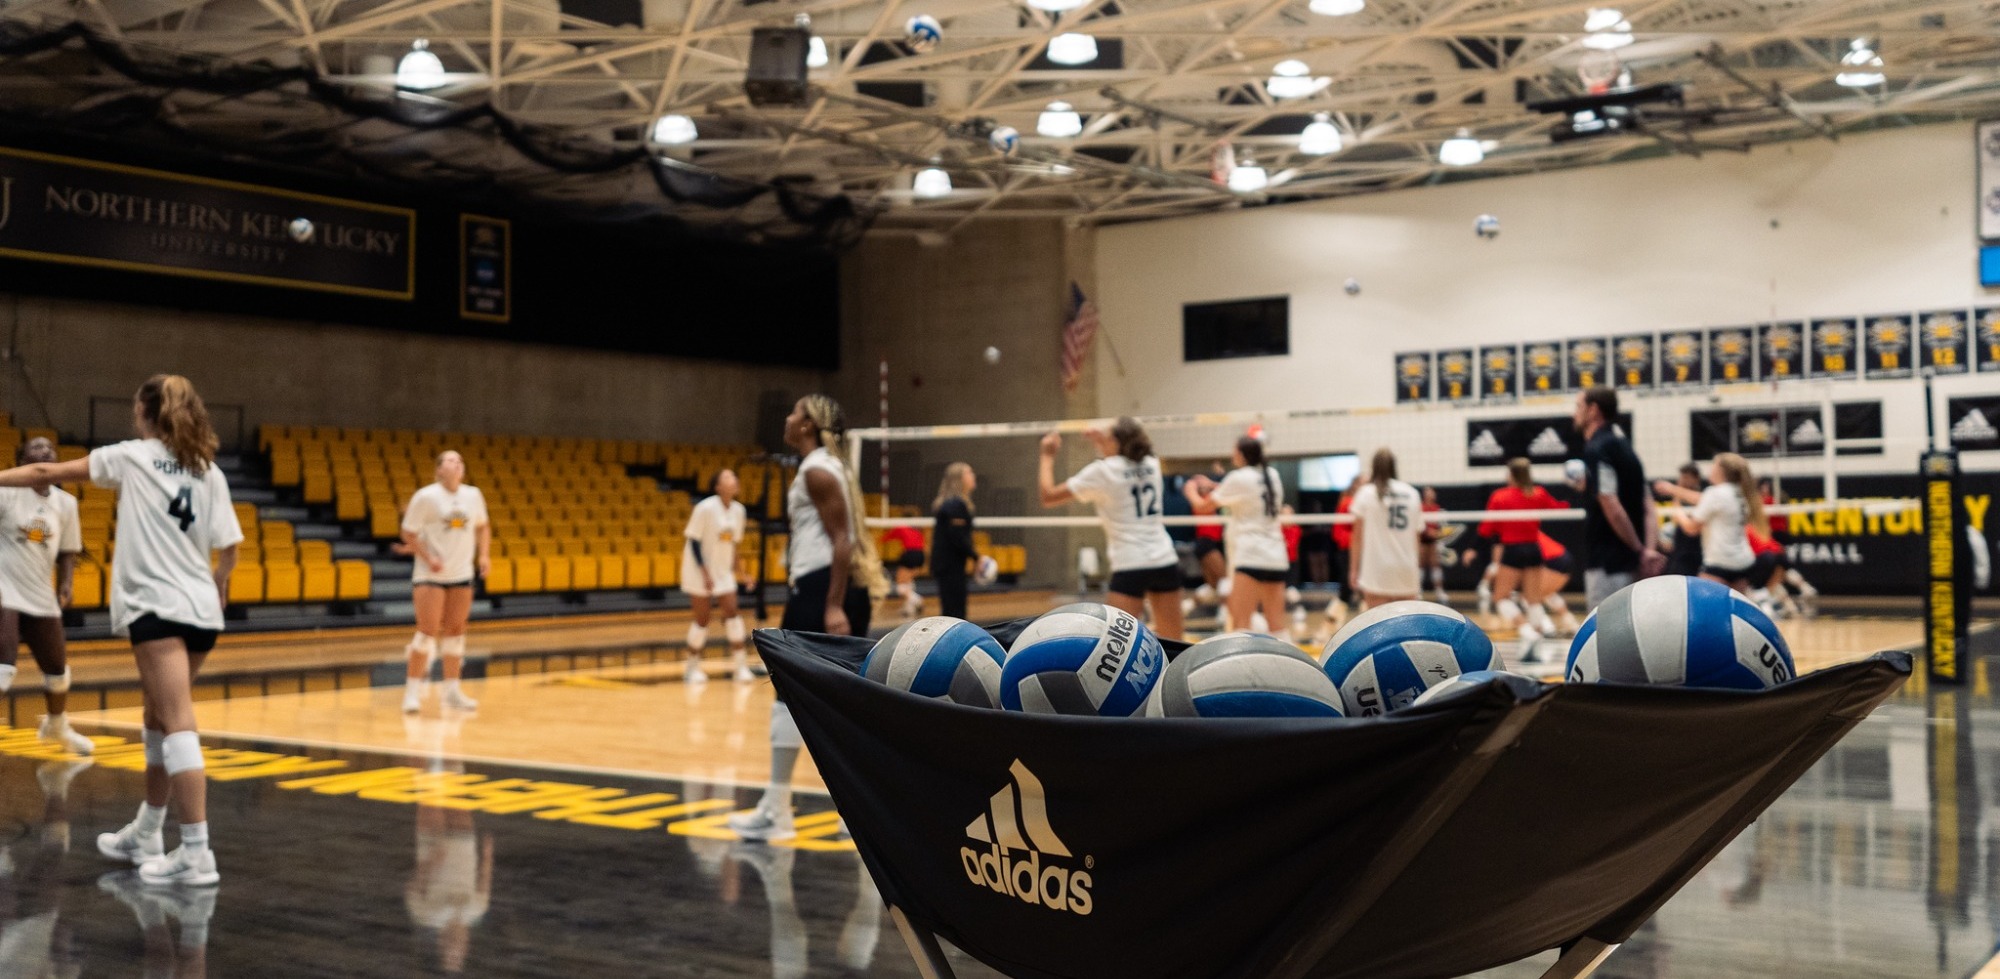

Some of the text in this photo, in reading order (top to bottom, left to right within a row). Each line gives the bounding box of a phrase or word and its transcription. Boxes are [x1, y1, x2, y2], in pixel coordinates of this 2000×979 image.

[45, 184, 233, 232] NORTHERN
[168, 486, 195, 533] 4
[1131, 482, 1158, 517] 12
[1388, 503, 1409, 530] 15
[1788, 495, 1990, 536] KENTUY
[1096, 611, 1134, 682] molten
[1125, 626, 1160, 698] NCAA
[276, 765, 857, 851] ORTHERN
[960, 843, 1093, 915] adidas
